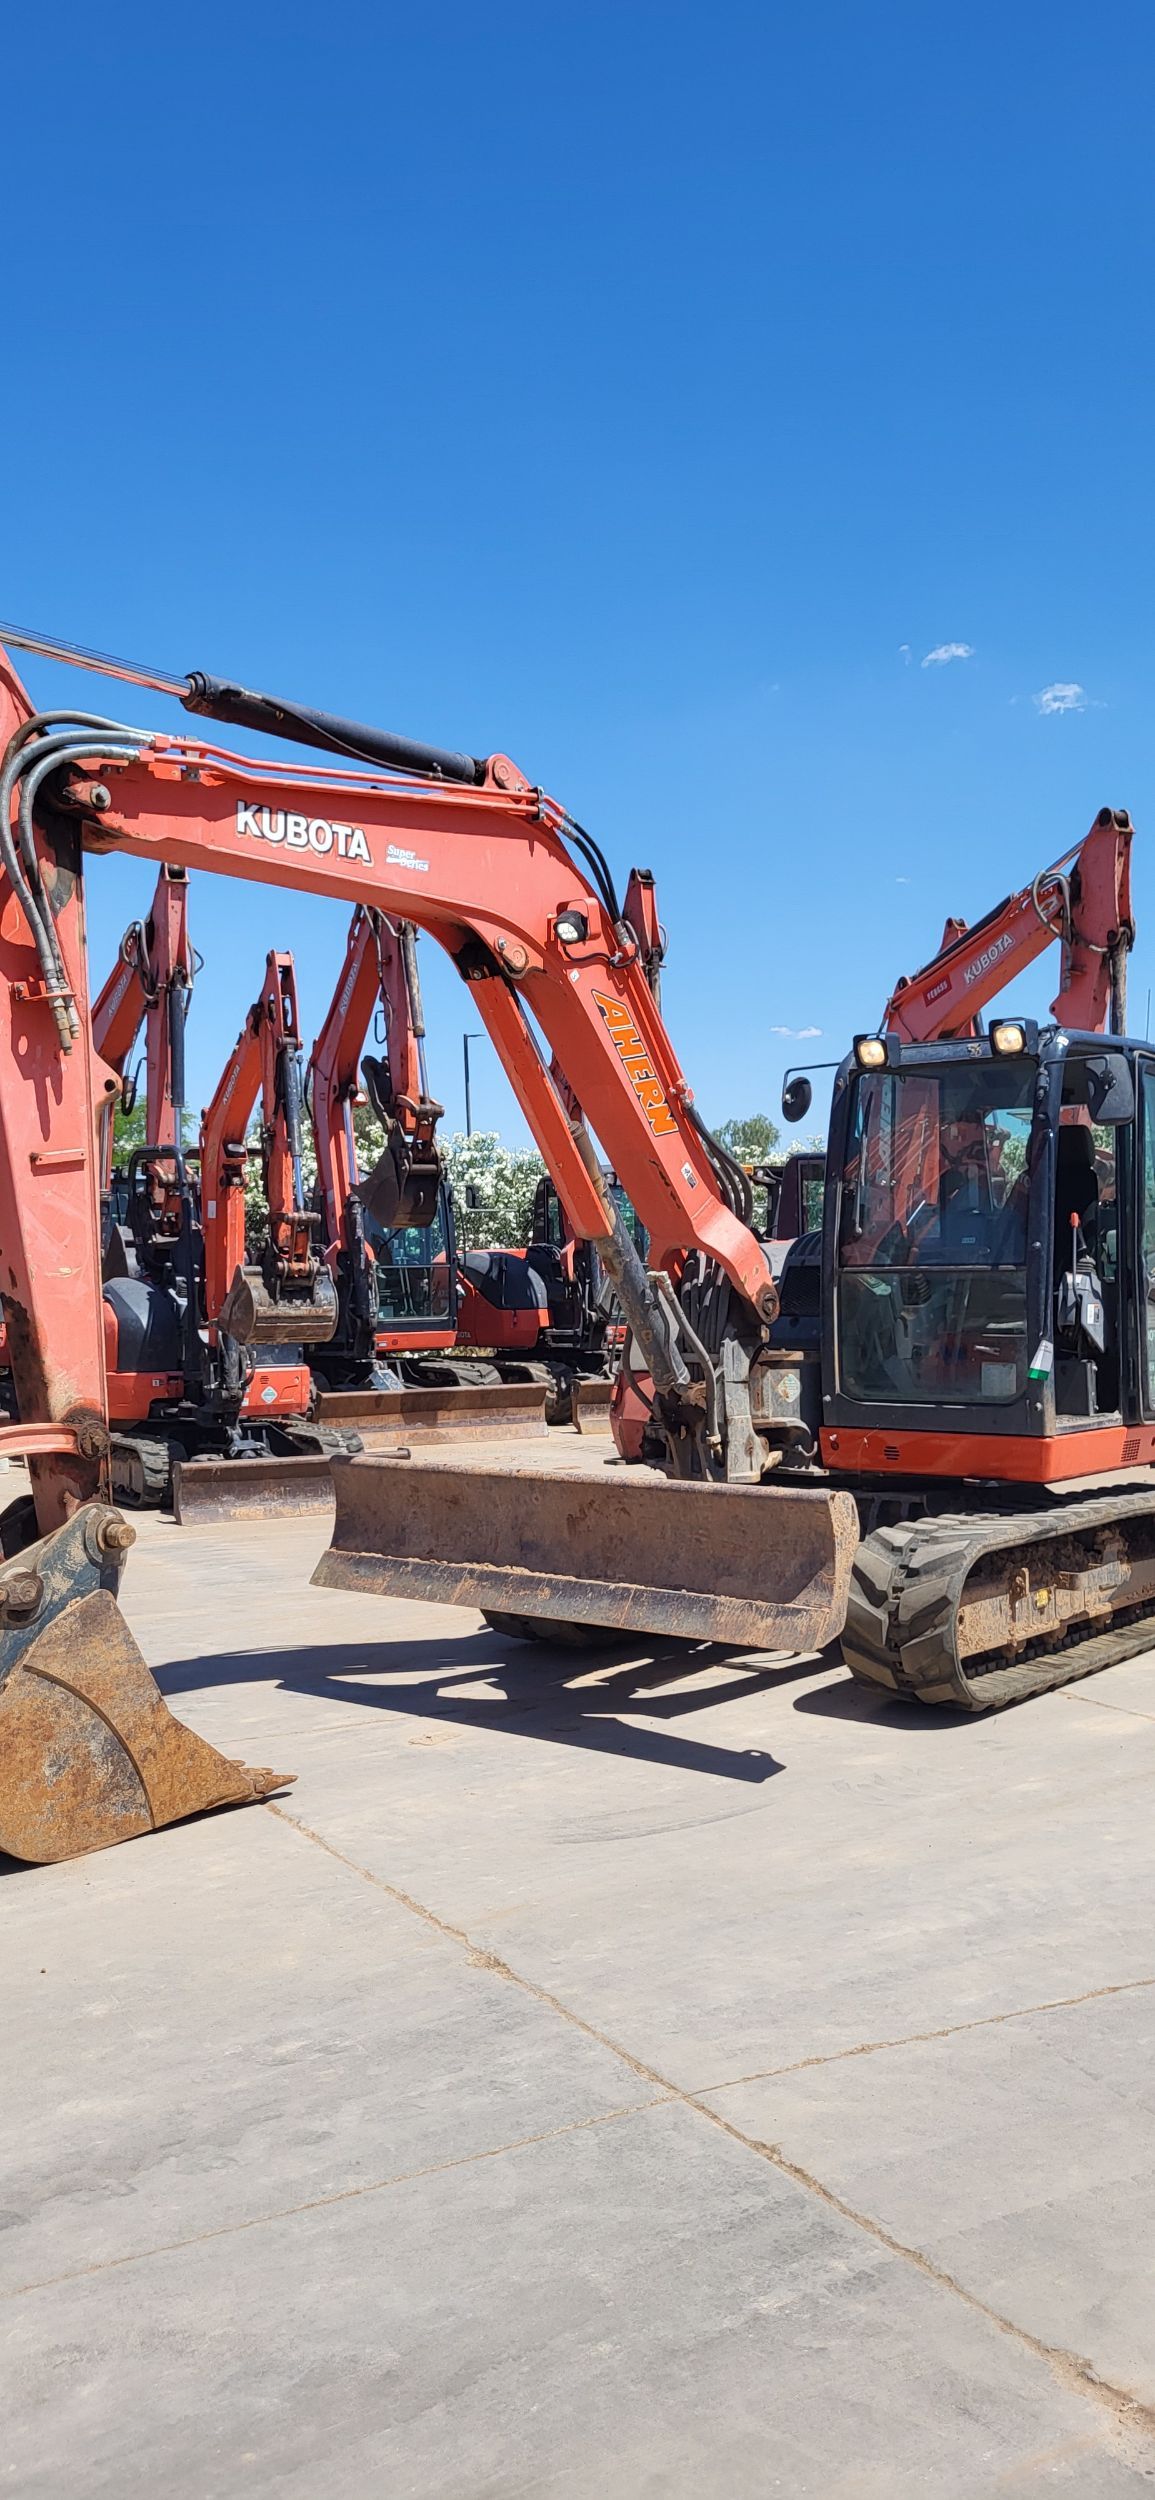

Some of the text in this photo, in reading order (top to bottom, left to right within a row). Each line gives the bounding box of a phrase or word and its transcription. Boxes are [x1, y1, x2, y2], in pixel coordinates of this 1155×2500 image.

[236, 800, 372, 863] KUBOTA
[387, 844, 416, 859] Super
[963, 932, 1014, 984] KUBOTA
[591, 988, 679, 1138] AHERN
